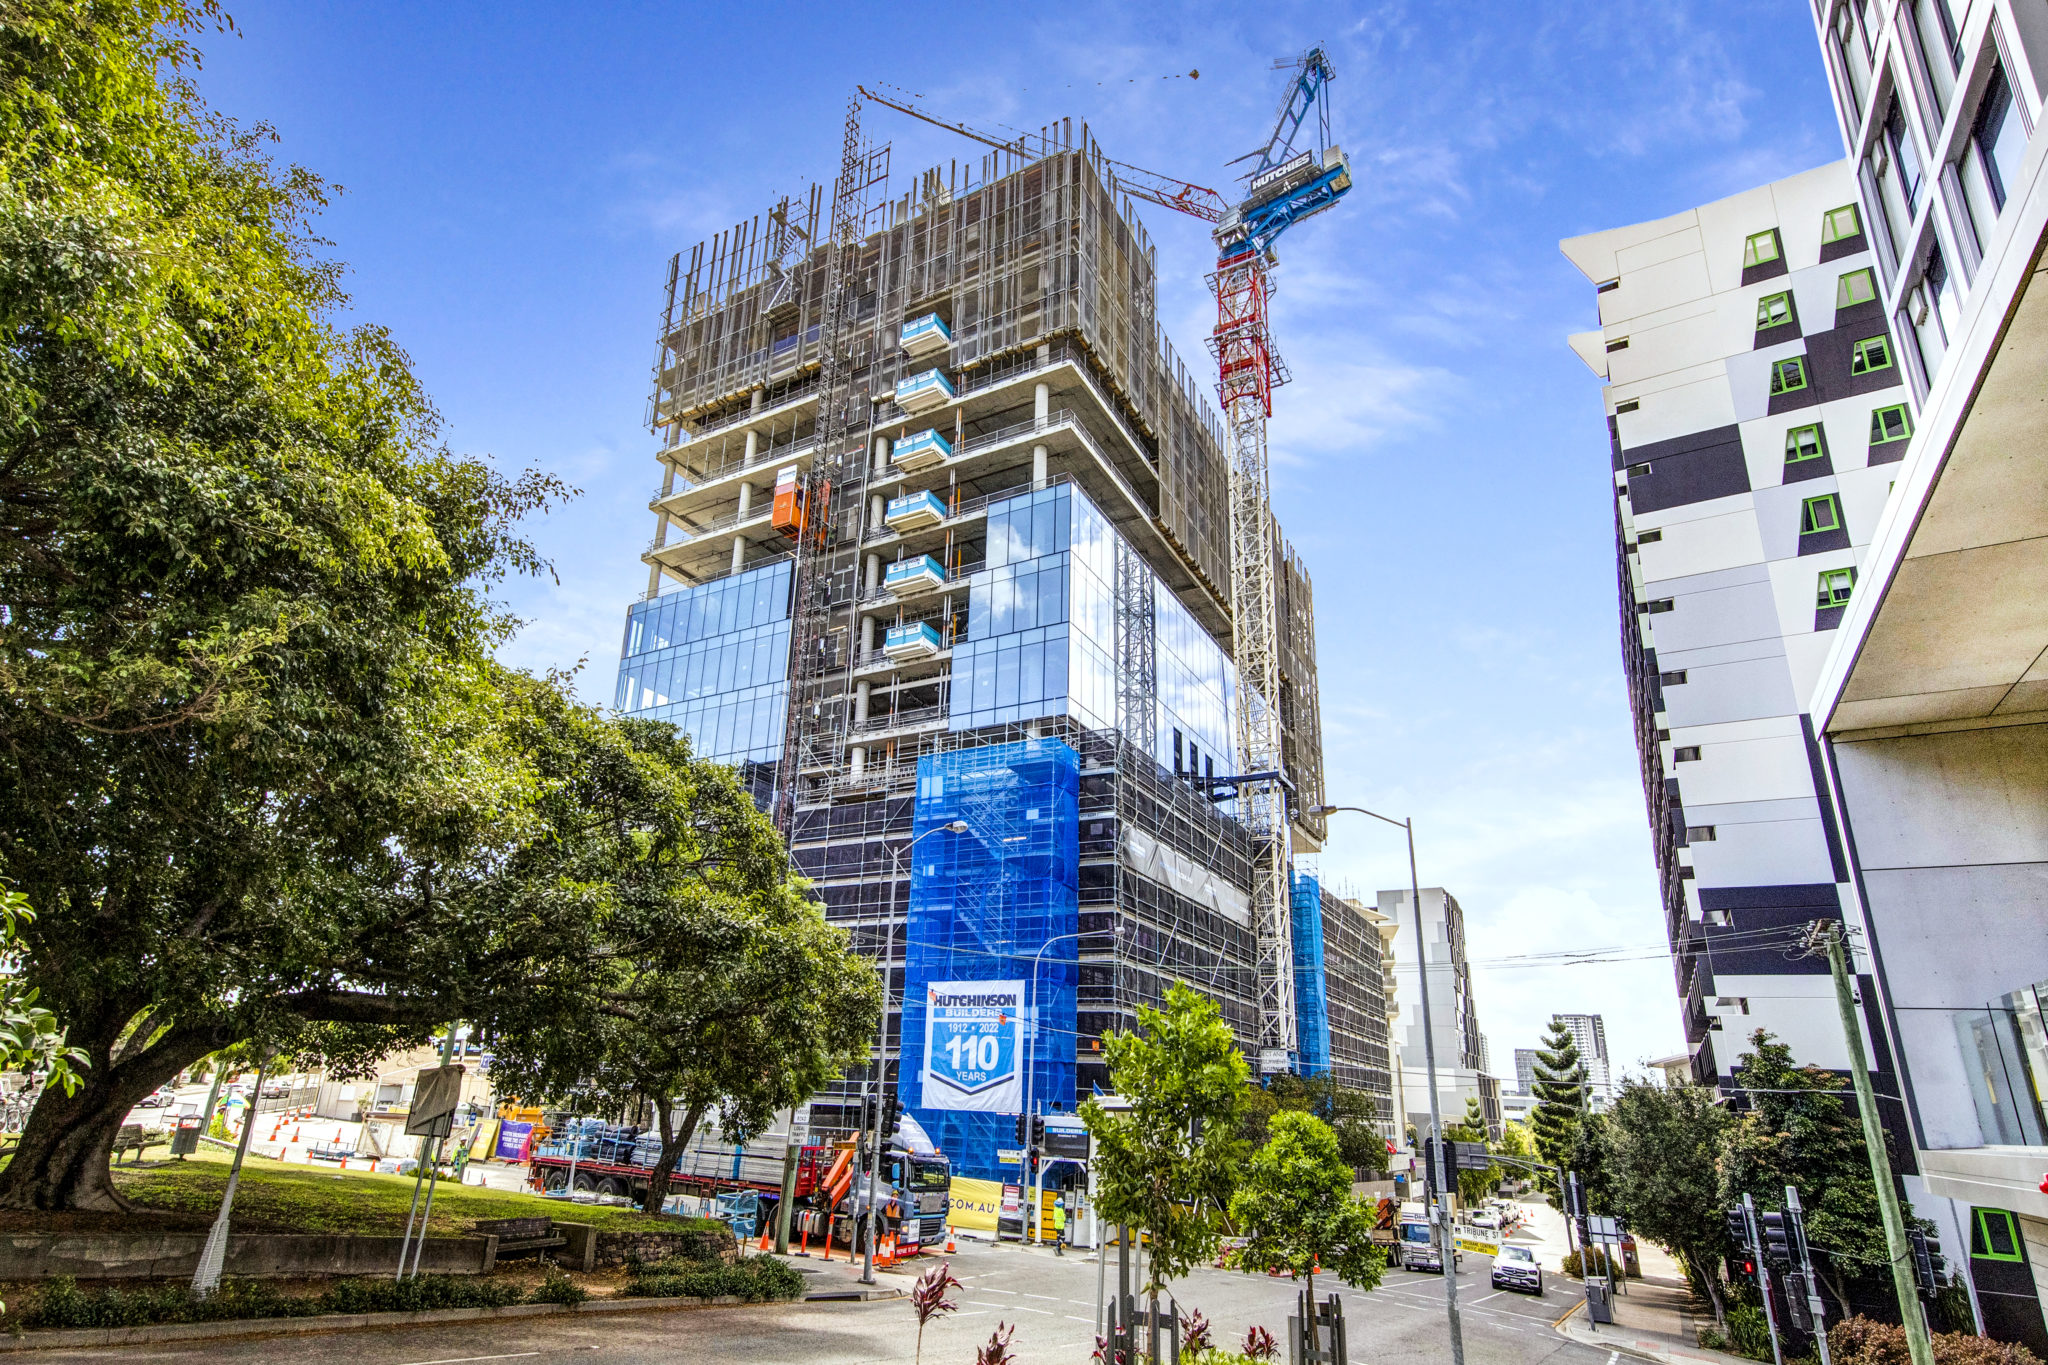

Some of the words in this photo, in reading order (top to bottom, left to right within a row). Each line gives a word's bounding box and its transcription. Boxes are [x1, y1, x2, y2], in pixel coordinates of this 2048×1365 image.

[1252, 153, 1310, 190] HUTCHIES
[934, 994, 1017, 1007] HUTCHINSON
[945, 1008, 1003, 1017] BUILDERS
[948, 1023, 968, 1033] 1912
[979, 1023, 999, 1033] 2022
[945, 1034, 1000, 1071] 110
[956, 1071, 987, 1081] YEARS
[1463, 1226, 1489, 1237] TRIBUNE
[1492, 1231, 1499, 1239] ST
